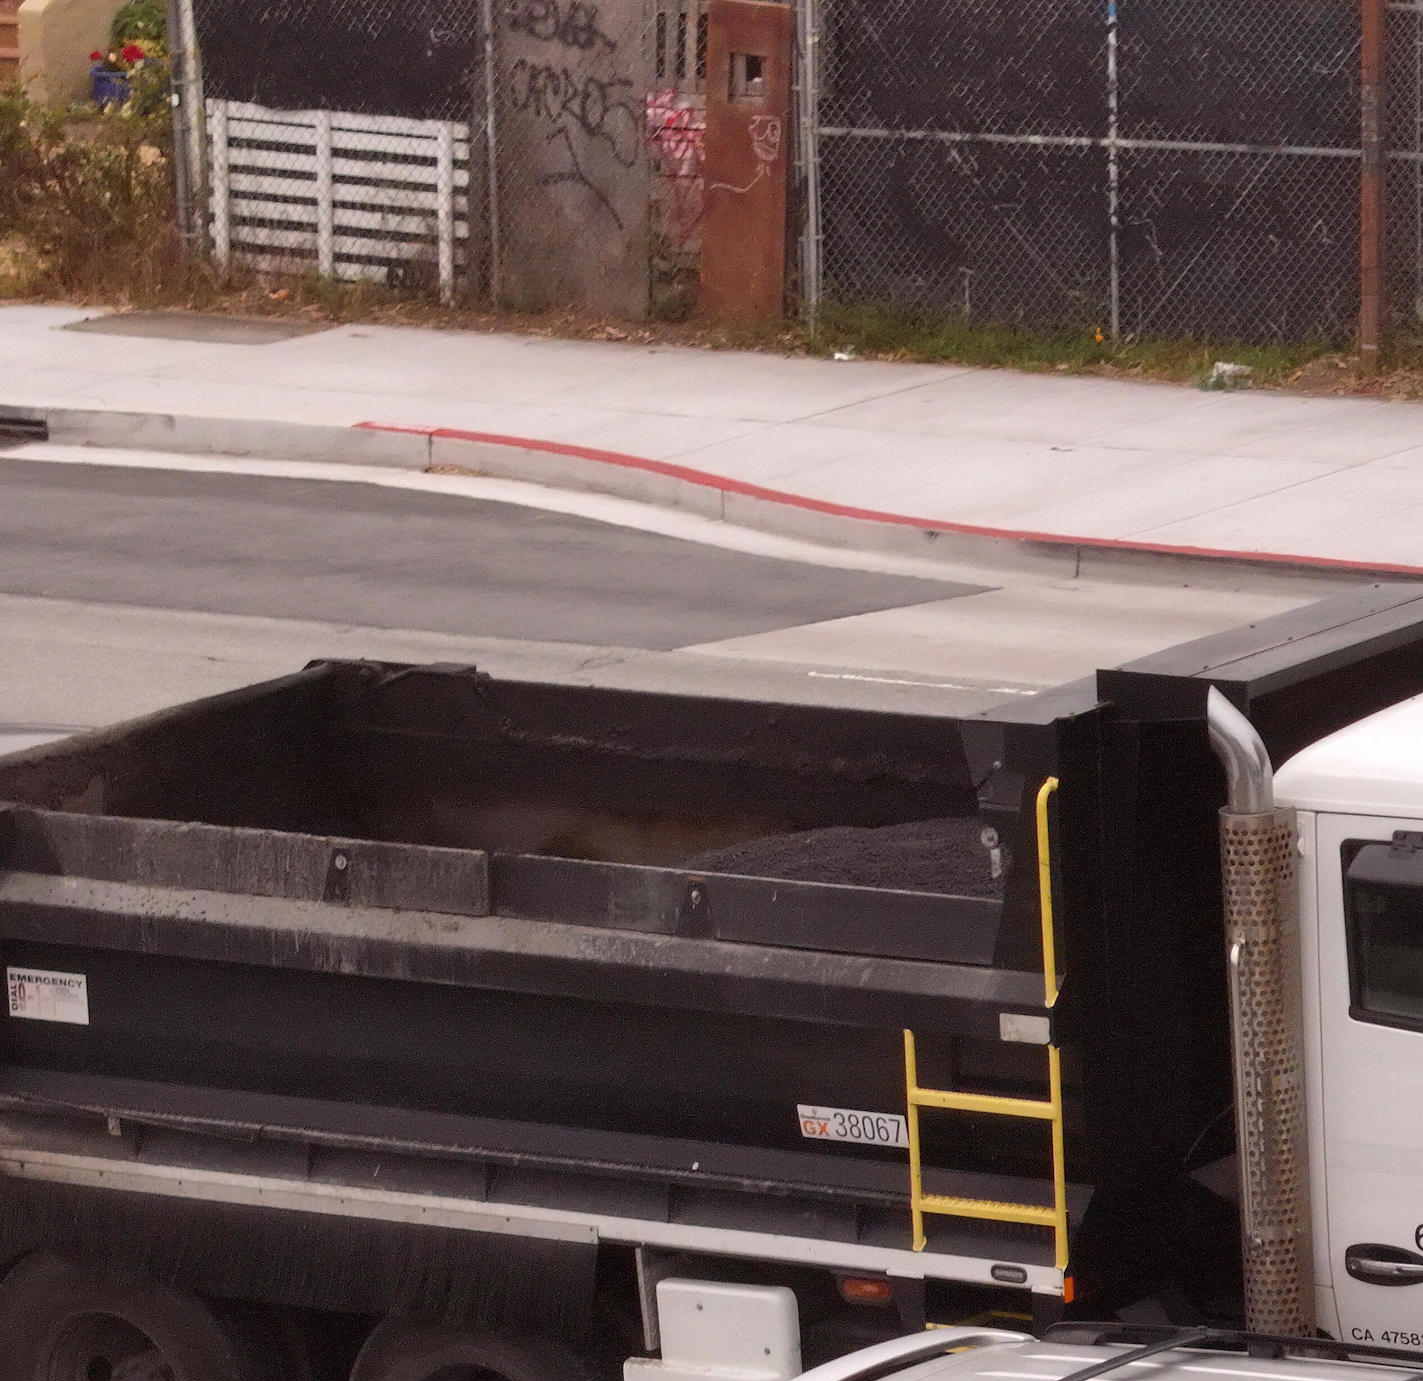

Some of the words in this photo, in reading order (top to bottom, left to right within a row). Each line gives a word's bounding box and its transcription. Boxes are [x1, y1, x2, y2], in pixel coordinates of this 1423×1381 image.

[10, 973, 83, 988] EMERGENCY
[10, 985, 18, 1010] DIAL
[833, 1112, 901, 1143] 38067
[1352, 1327, 1374, 1342] CA
